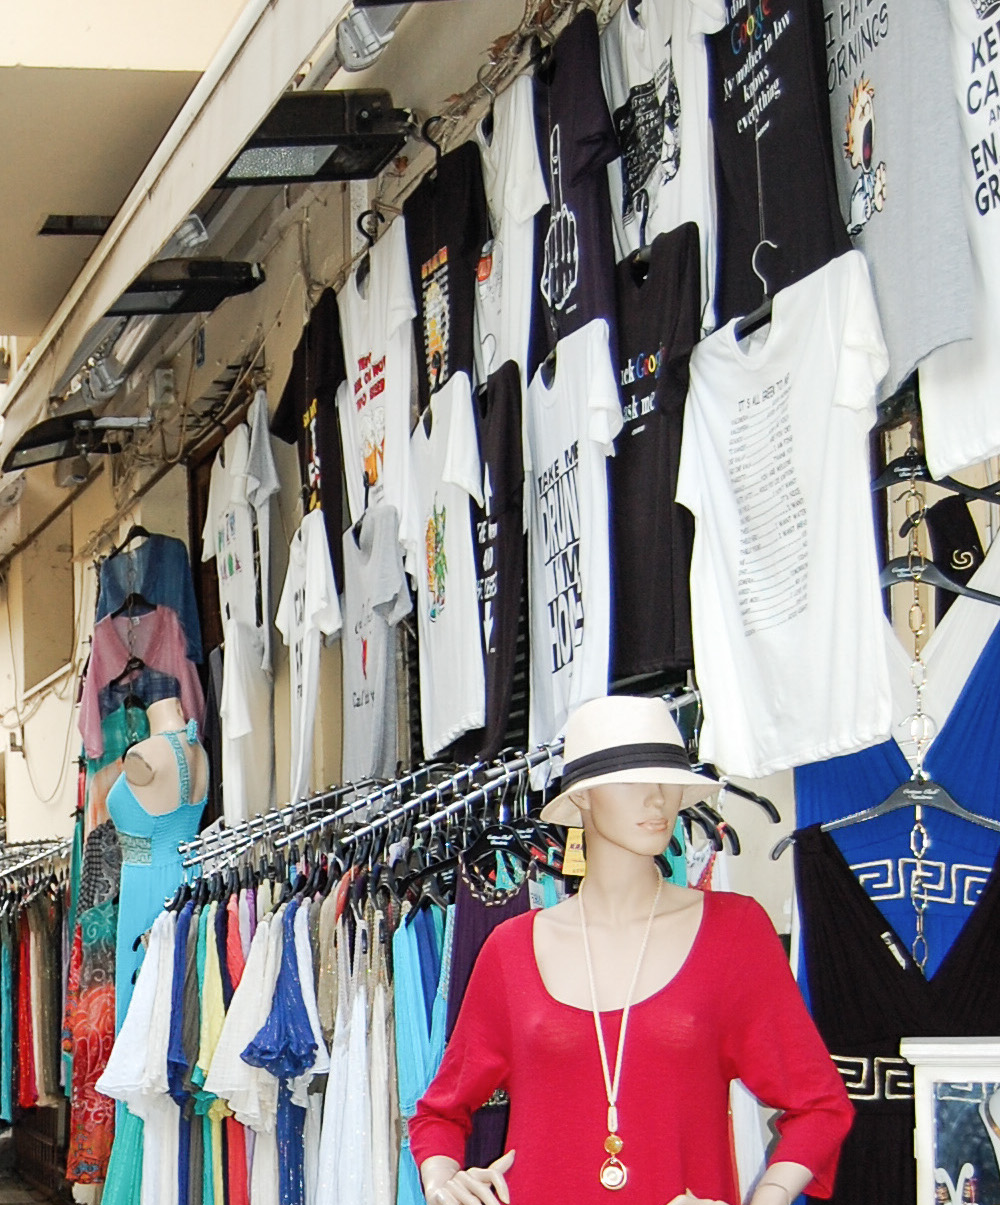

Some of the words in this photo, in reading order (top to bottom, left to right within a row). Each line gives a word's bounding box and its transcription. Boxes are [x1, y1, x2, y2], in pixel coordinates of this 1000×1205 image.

[824, 12, 835, 49] I
[841, 0, 873, 36] HA
[828, 3, 888, 94] ORNINGS
[971, 21, 1000, 73] KE
[538, 459, 559, 494] TAKE
